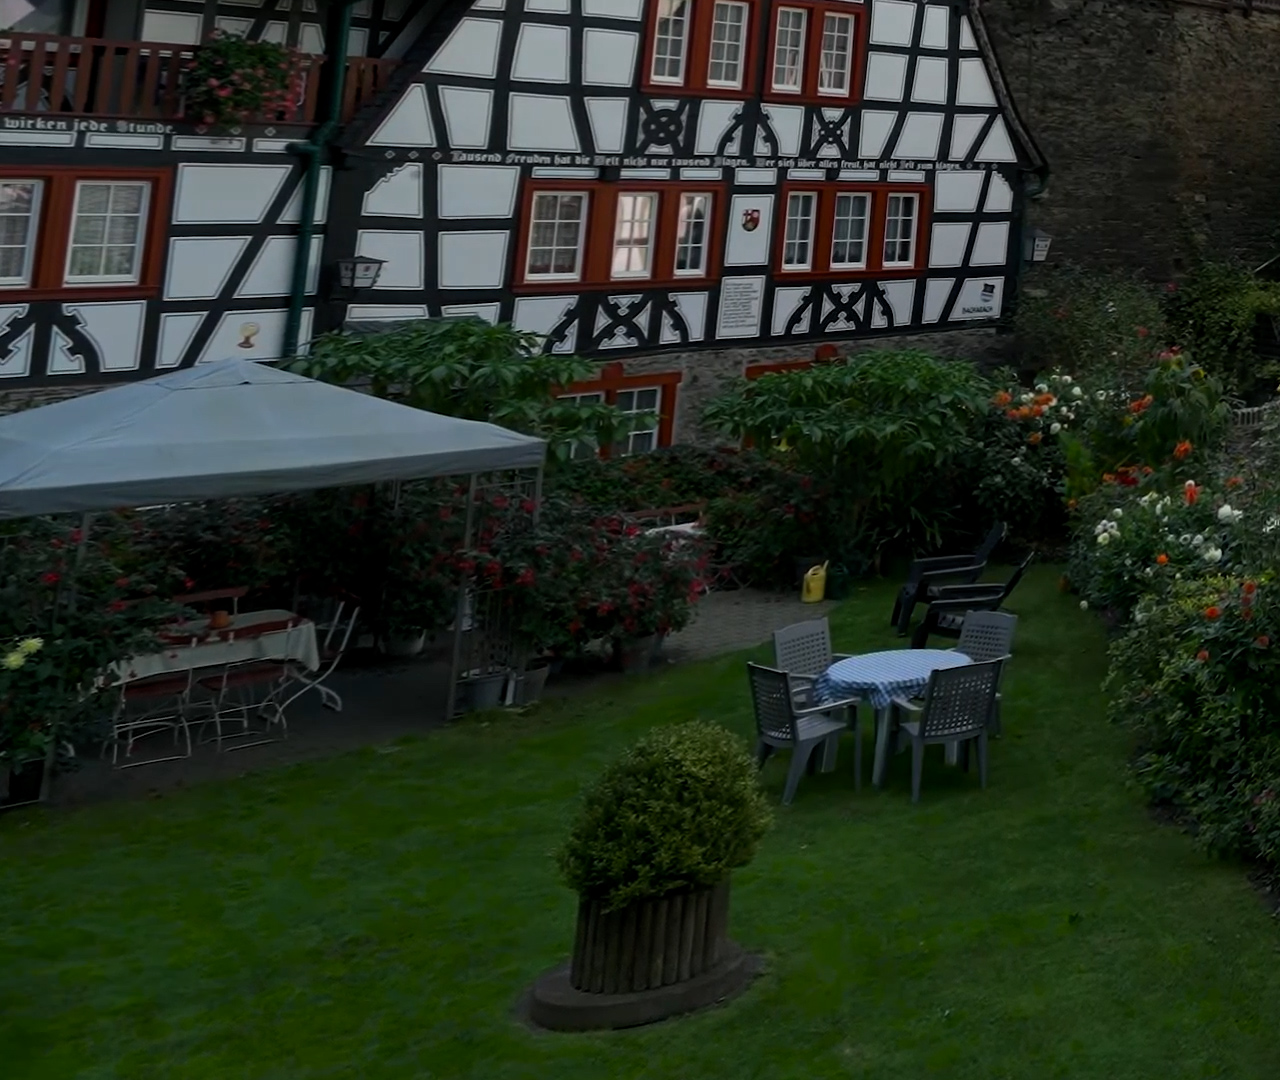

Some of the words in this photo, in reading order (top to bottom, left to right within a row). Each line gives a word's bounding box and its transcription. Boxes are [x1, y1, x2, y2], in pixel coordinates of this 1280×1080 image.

[4, 116, 67, 130] wirken
[73, 118, 108, 132] jede
[116, 119, 177, 134] Stunde.
[450, 150, 502, 162] Tausend
[505, 153, 551, 164] Freuden
[554, 154, 571, 165] hat
[575, 154, 590, 165] die
[623, 156, 647, 167] nicht
[651, 158, 668, 166] nur
[671, 157, 710, 167] tausend
[778, 158, 794, 168] sich
[797, 158, 816, 168] über
[819, 159, 838, 168] alles
[863, 160, 876, 169] hat
[879, 160, 897, 170] nicht
